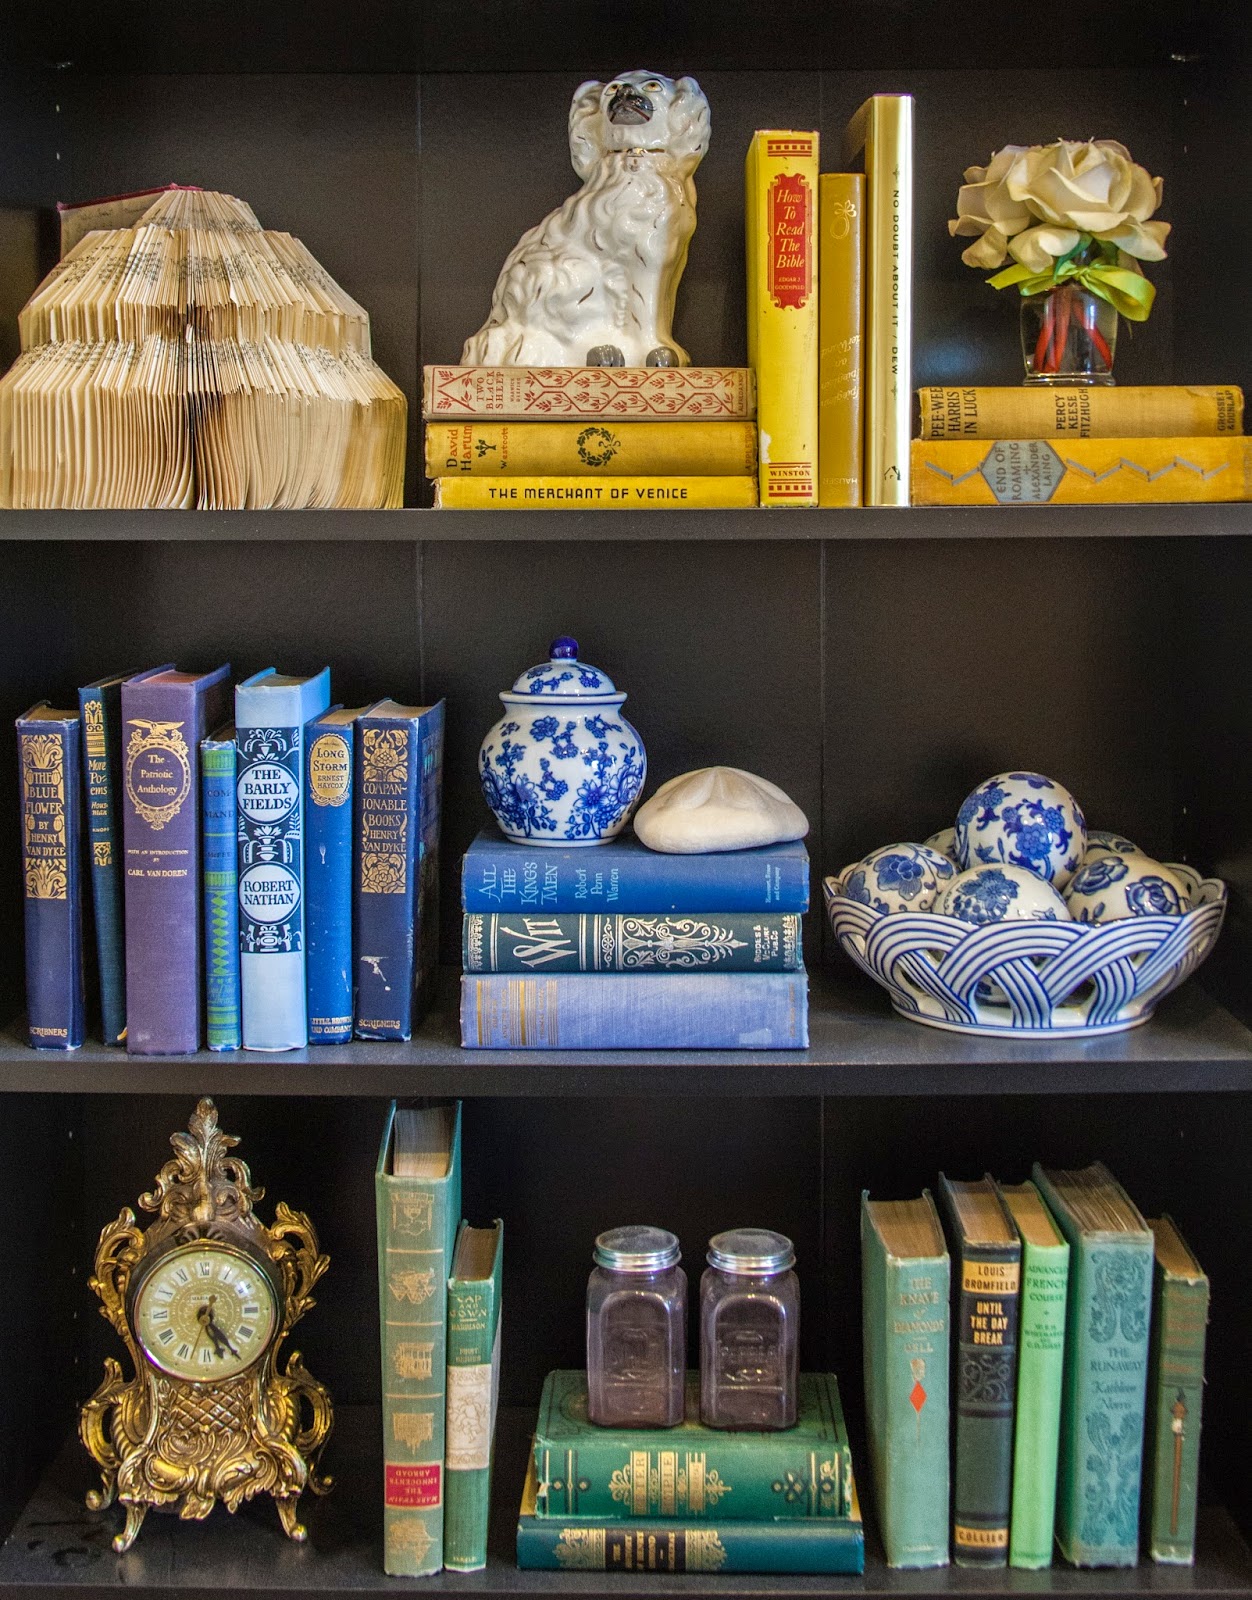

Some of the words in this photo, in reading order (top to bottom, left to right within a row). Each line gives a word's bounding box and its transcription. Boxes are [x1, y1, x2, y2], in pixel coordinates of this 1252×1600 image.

[777, 189, 803, 204] How
[893, 189, 900, 209] NO
[783, 205, 797, 220] To
[776, 222, 804, 236] Read
[892, 214, 900, 260] DOUBT
[780, 238, 801, 252] The
[776, 254, 805, 269] Bible
[892, 266, 900, 311] ABOUT
[892, 314, 900, 328] IT
[891, 346, 899, 375] DEW
[476, 376, 485, 402] TWO
[485, 370, 495, 410] BLACK
[495, 371, 504, 410] SHEEP
[963, 388, 978, 418] LUCK
[947, 390, 961, 432] HARRIS
[1055, 394, 1066, 430] PERCY
[1067, 395, 1079, 430] KEESE
[1079, 388, 1091, 438] FITZHUGH
[964, 421, 978, 434] IN
[446, 428, 459, 468] David
[460, 425, 473, 471] Harum
[500, 426, 509, 469] Westcott
[995, 446, 1005, 463] OF
[769, 469, 811, 477] WINSTON
[1009, 442, 1022, 501] ROAMING
[1029, 441, 1040, 499] ALEXANDER
[1041, 453, 1051, 486] LAING
[489, 487, 518, 499] THE
[524, 487, 603, 500] MERCHANT
[610, 487, 630, 500] OF
[636, 487, 688, 500] VENICE
[148, 755, 165, 764] The
[316, 747, 345, 758] LONG
[88, 760, 107, 771] More
[313, 760, 347, 772] STORM
[33, 772, 53, 784] THE
[140, 769, 173, 779] Patriotic
[252, 769, 281, 780] THE
[317, 774, 344, 782] ERNEST
[90, 785, 108, 796] ems
[137, 784, 178, 796] Anthology
[244, 782, 292, 795] BARLY
[317, 781, 344, 790] HAYCOX
[29, 787, 58, 799] BLUE
[25, 802, 63, 815] FLOWER
[243, 796, 292, 810] FIELDS
[362, 798, 407, 810] IONABLE
[38, 821, 49, 831] BY
[368, 813, 401, 826] BOOKS
[30, 833, 58, 845] HENRY
[370, 829, 399, 840] HENRY
[26, 847, 41, 856] VAN
[43, 846, 66, 856] DYKE
[362, 842, 381, 851] VAN
[381, 842, 406, 852] DYKE
[127, 869, 145, 877] CARL
[146, 869, 162, 877] VAN
[161, 868, 188, 877] DOREN
[243, 880, 294, 892] ROBERT
[479, 863, 501, 903] ALL
[500, 867, 517, 898] THE
[519, 861, 538, 905] KING'S
[540, 862, 559, 905] MEN
[575, 867, 587, 899] Robert
[590, 872, 603, 896] Penn
[607, 868, 619, 902] Warren
[243, 892, 294, 905] NATHAN
[753, 932, 762, 963] RHODES
[358, 1018, 401, 1029] SCRIBNERS
[30, 1027, 68, 1038] SCRIBNERS
[978, 1265, 1005, 1276] LOUIS
[964, 1279, 1017, 1290] BROMFIELD
[900, 1292, 940, 1306] KNAVE
[976, 1301, 1003, 1315] UNTIL
[894, 1320, 945, 1334] DIAMONDS
[970, 1317, 988, 1330] THE
[990, 1317, 1009, 1331] DAY
[973, 1331, 1003, 1345] BREAK
[1107, 1347, 1131, 1358] THE
[1090, 1359, 1145, 1372] RUNAWAY
[395, 1469, 430, 1477] ABROAD
[389, 1476, 437, 1485] INNOCENTS
[404, 1487, 422, 1495] THE
[958, 1532, 1005, 1543] COLLIER
